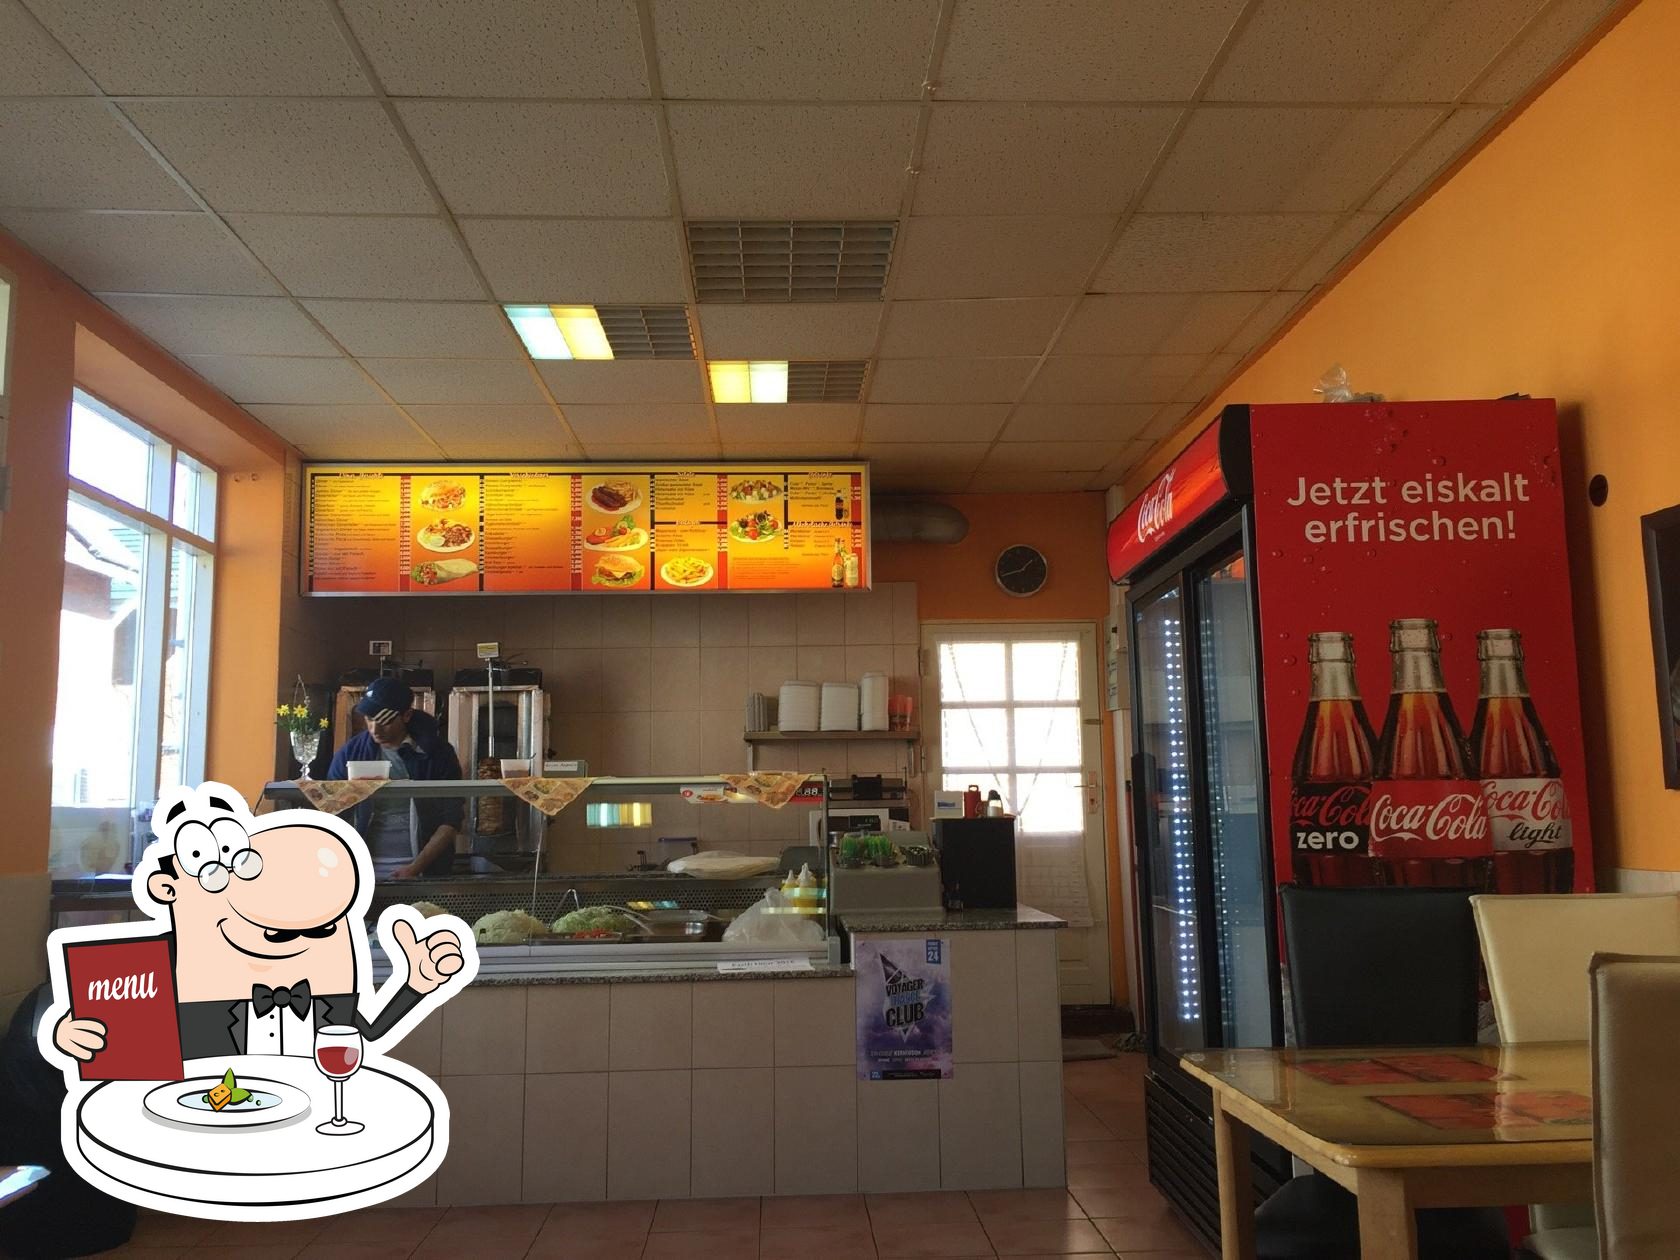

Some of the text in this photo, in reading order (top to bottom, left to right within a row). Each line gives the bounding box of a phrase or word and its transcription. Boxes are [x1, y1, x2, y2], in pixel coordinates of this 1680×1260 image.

[1287, 472, 1530, 506] Jetzt eiskalt
[1304, 510, 1516, 543] erfrischen!
[1296, 831, 1360, 850] zero
[1507, 822, 1561, 848] light
[927, 951, 939, 962] 24
[886, 978, 924, 996] VOYAGER
[886, 1002, 924, 1027] CLUB
